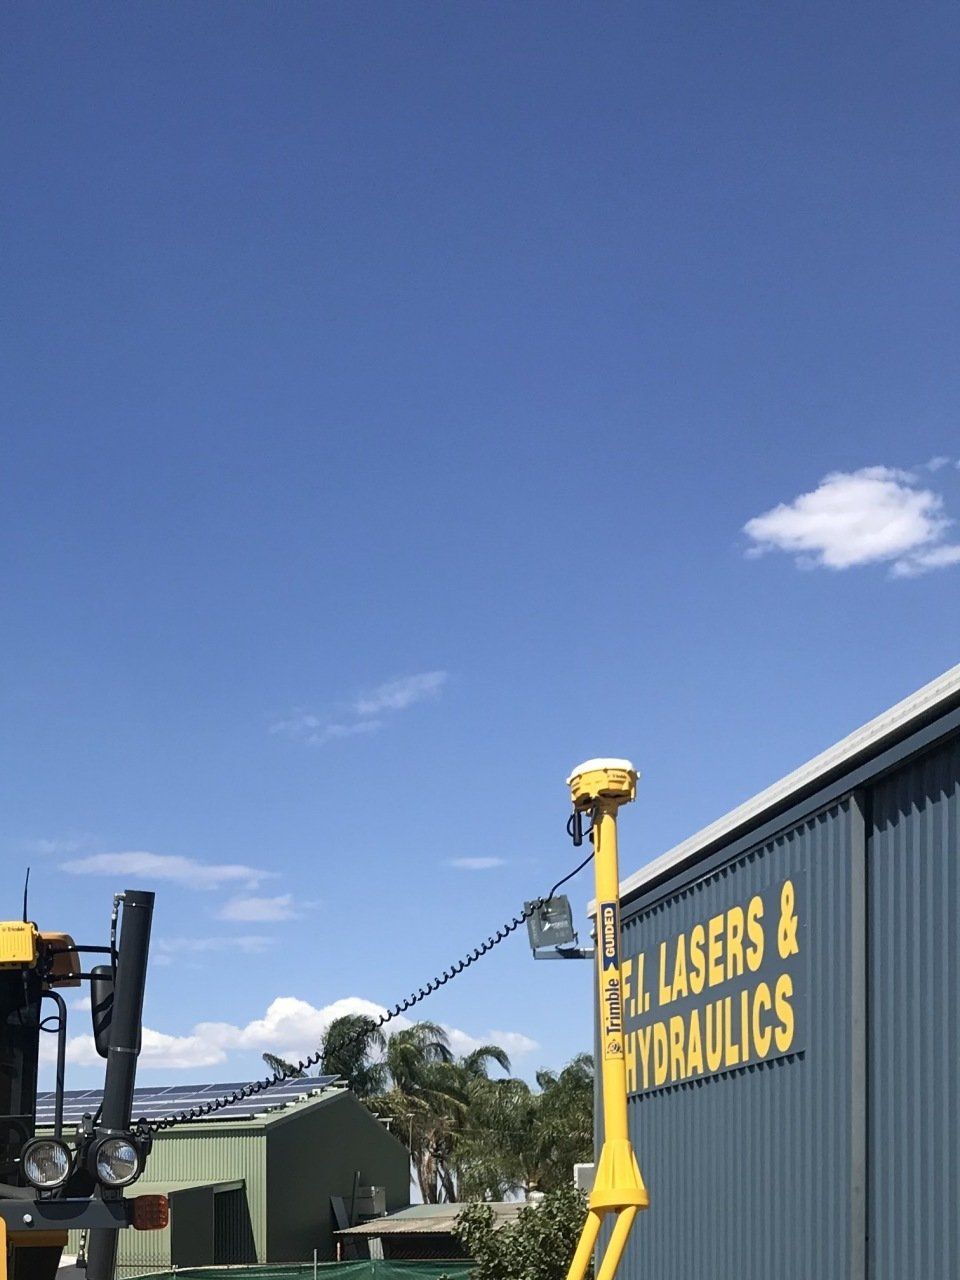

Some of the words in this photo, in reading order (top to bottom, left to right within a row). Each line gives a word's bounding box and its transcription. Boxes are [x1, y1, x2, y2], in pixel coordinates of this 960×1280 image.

[604, 906, 616, 959] GUIDED
[658, 895, 765, 1007] LASERS
[777, 879, 800, 960] &
[605, 977, 621, 1036] Trimble
[624, 973, 795, 1094] HYDRAULICS
